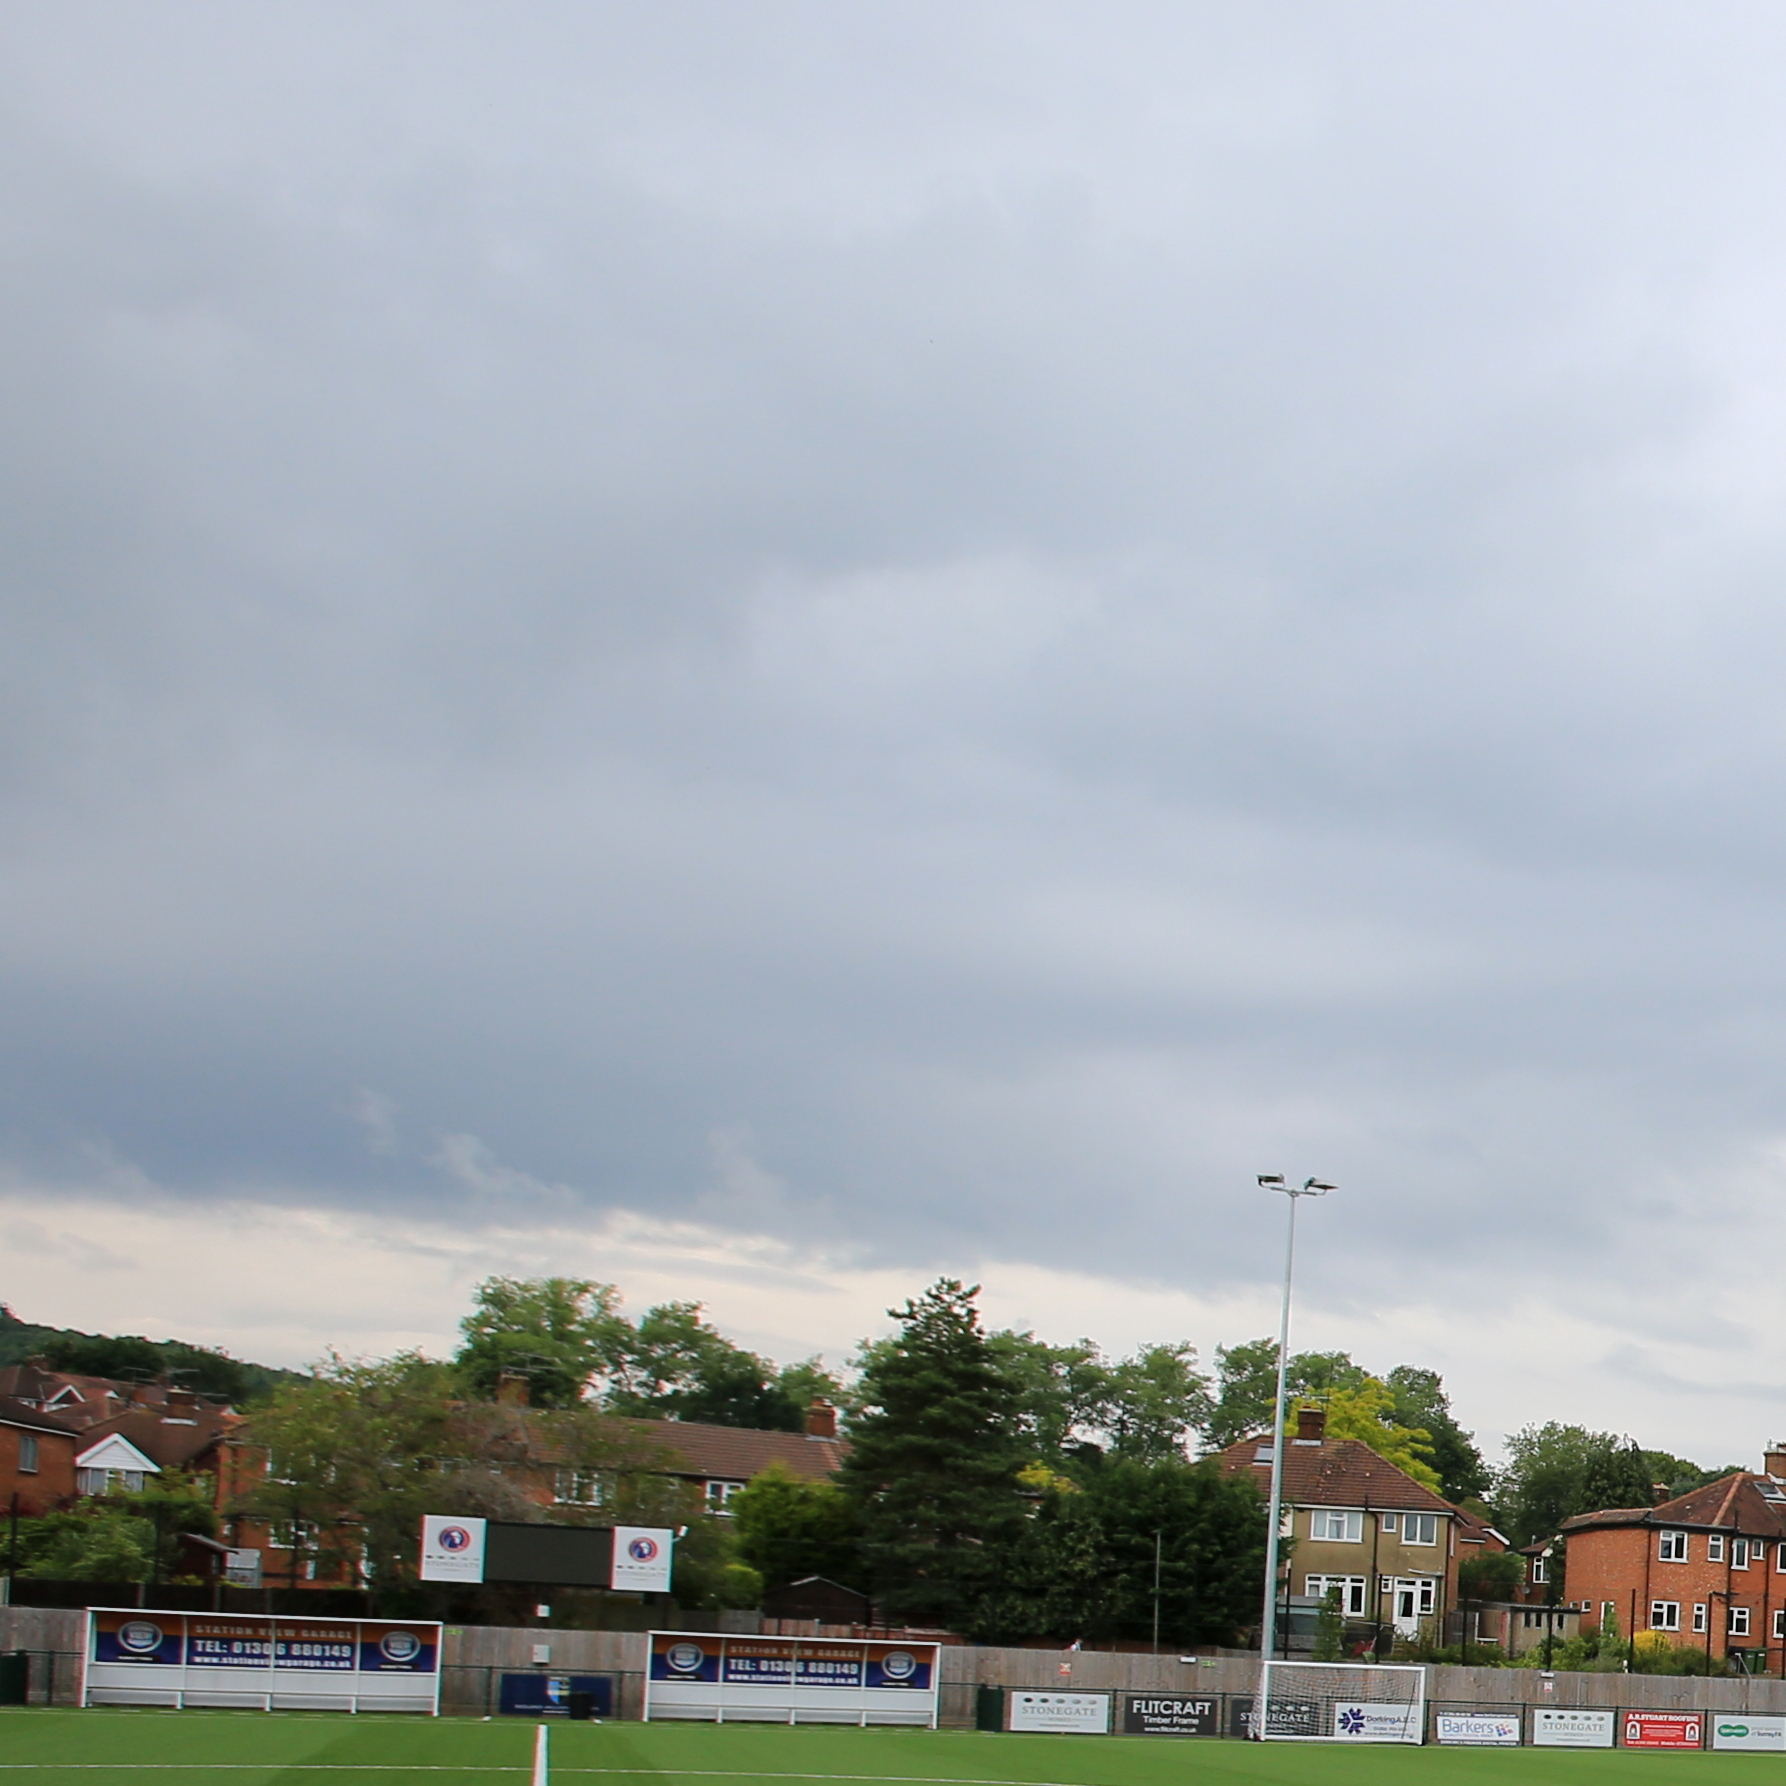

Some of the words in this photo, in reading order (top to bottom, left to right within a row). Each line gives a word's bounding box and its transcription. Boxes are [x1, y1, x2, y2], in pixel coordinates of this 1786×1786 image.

[195, 1625, 254, 1635] STATION
[301, 1629, 352, 1639] GARAGE
[194, 1640, 228, 1652] TEL:
[231, 1641, 286, 1656] 01306
[290, 1643, 352, 1658] 880149
[730, 1646, 778, 1654] STATION
[729, 1659, 756, 1671] TEL:
[759, 1660, 804, 1673] 01306
[808, 1662, 859, 1675] 880149
[1022, 1706, 1098, 1716] STONEGATE
[1132, 1700, 1212, 1716] FLITCRAFT
[1143, 1715, 1171, 1724] Timber
[1172, 1716, 1200, 1725] Frame
[1442, 1718, 1495, 1733] Barkers
[1542, 1722, 1606, 1732] STONEGATE
